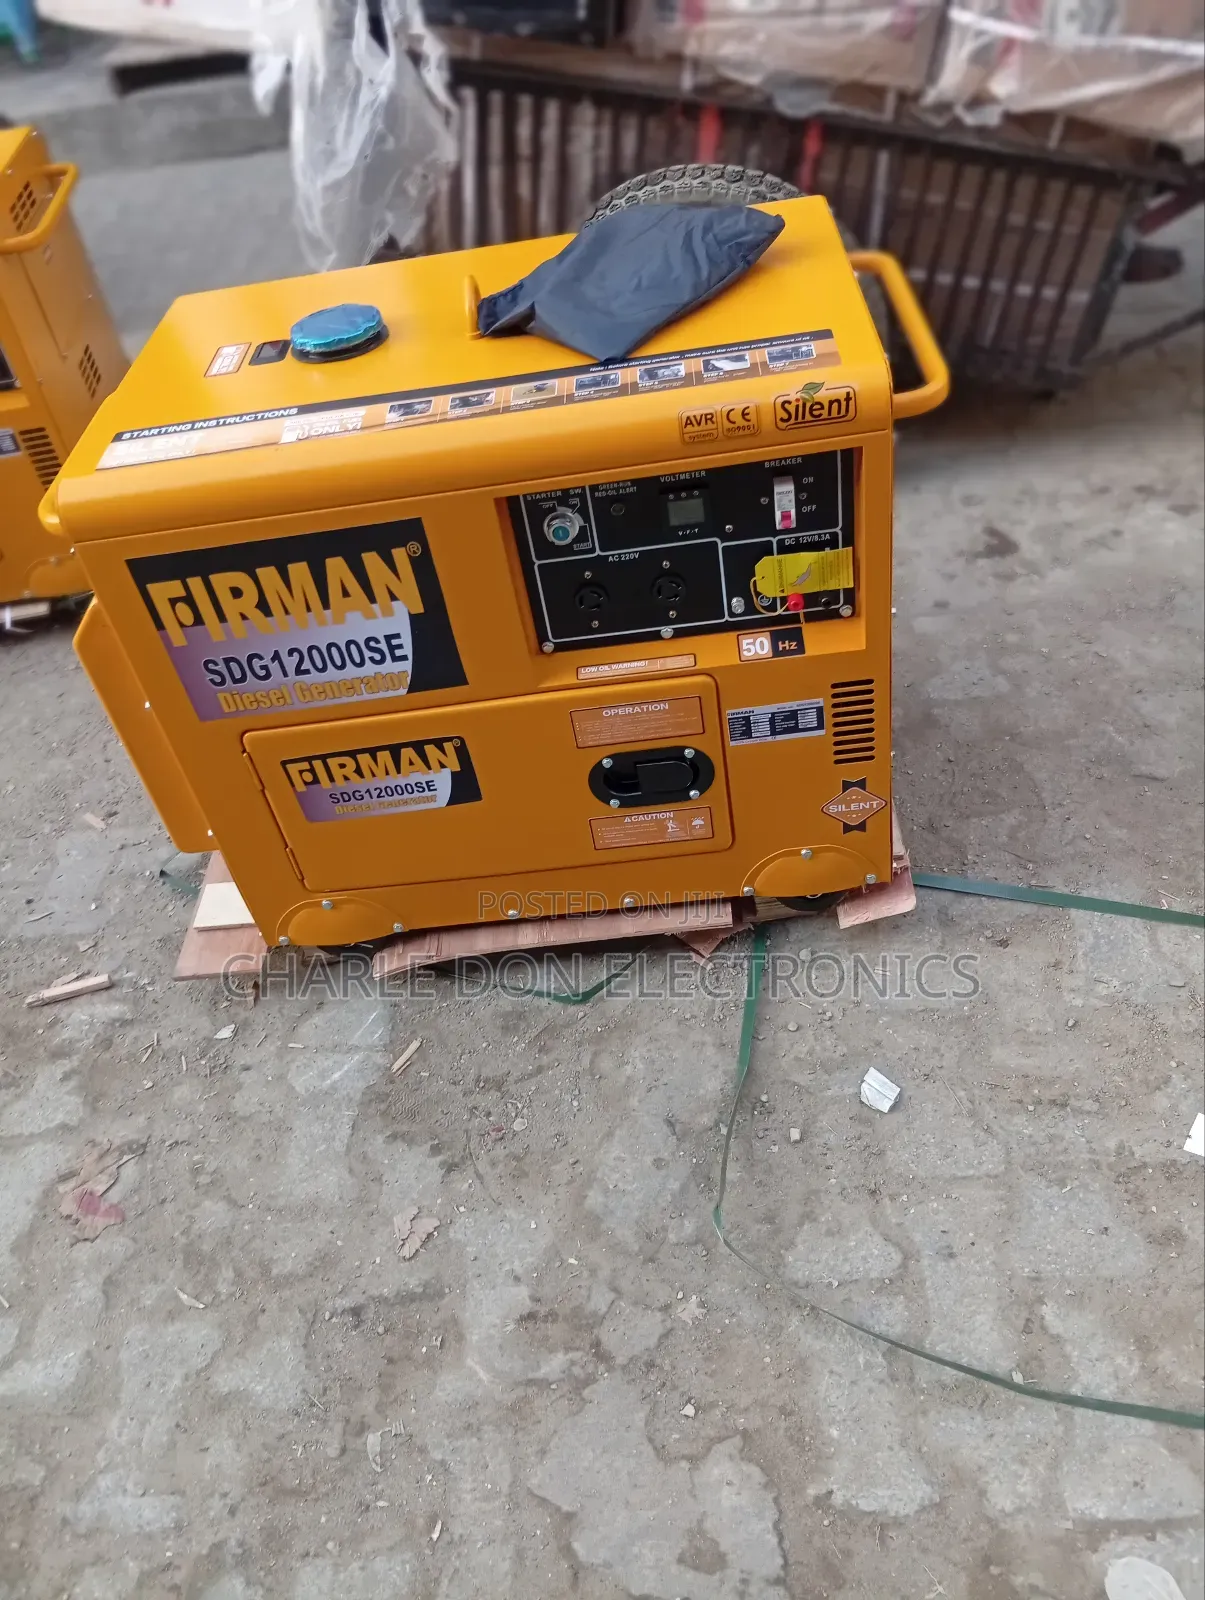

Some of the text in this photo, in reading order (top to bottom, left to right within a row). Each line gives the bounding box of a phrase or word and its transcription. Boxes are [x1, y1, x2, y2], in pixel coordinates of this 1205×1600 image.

[779, 391, 852, 423] Silent
[121, 423, 189, 440] STARTING
[193, 407, 299, 429] INSTRUCTIONS
[684, 412, 716, 429] AVR
[688, 432, 714, 442] system
[764, 457, 803, 468] BREAKER
[660, 470, 706, 483] VOLTMETER
[802, 476, 814, 484] ON
[526, 490, 562, 500] STARTER
[801, 504, 817, 513] OFF
[785, 533, 830, 546] DC 12V/8.3A
[620, 552, 640, 561] 220V
[742, 636, 798, 657] 50 Hz
[202, 632, 410, 688] SDG12000SE
[581, 666, 598, 674] LOW
[599, 664, 611, 672] OIL
[611, 660, 648, 670] WARNING!
[216, 669, 410, 713] Diesel Generator
[602, 702, 669, 717] OPERATION
[329, 779, 438, 804] SDG12000SE
[828, 800, 880, 813] SILENT
[631, 811, 674, 822] CAUTION
